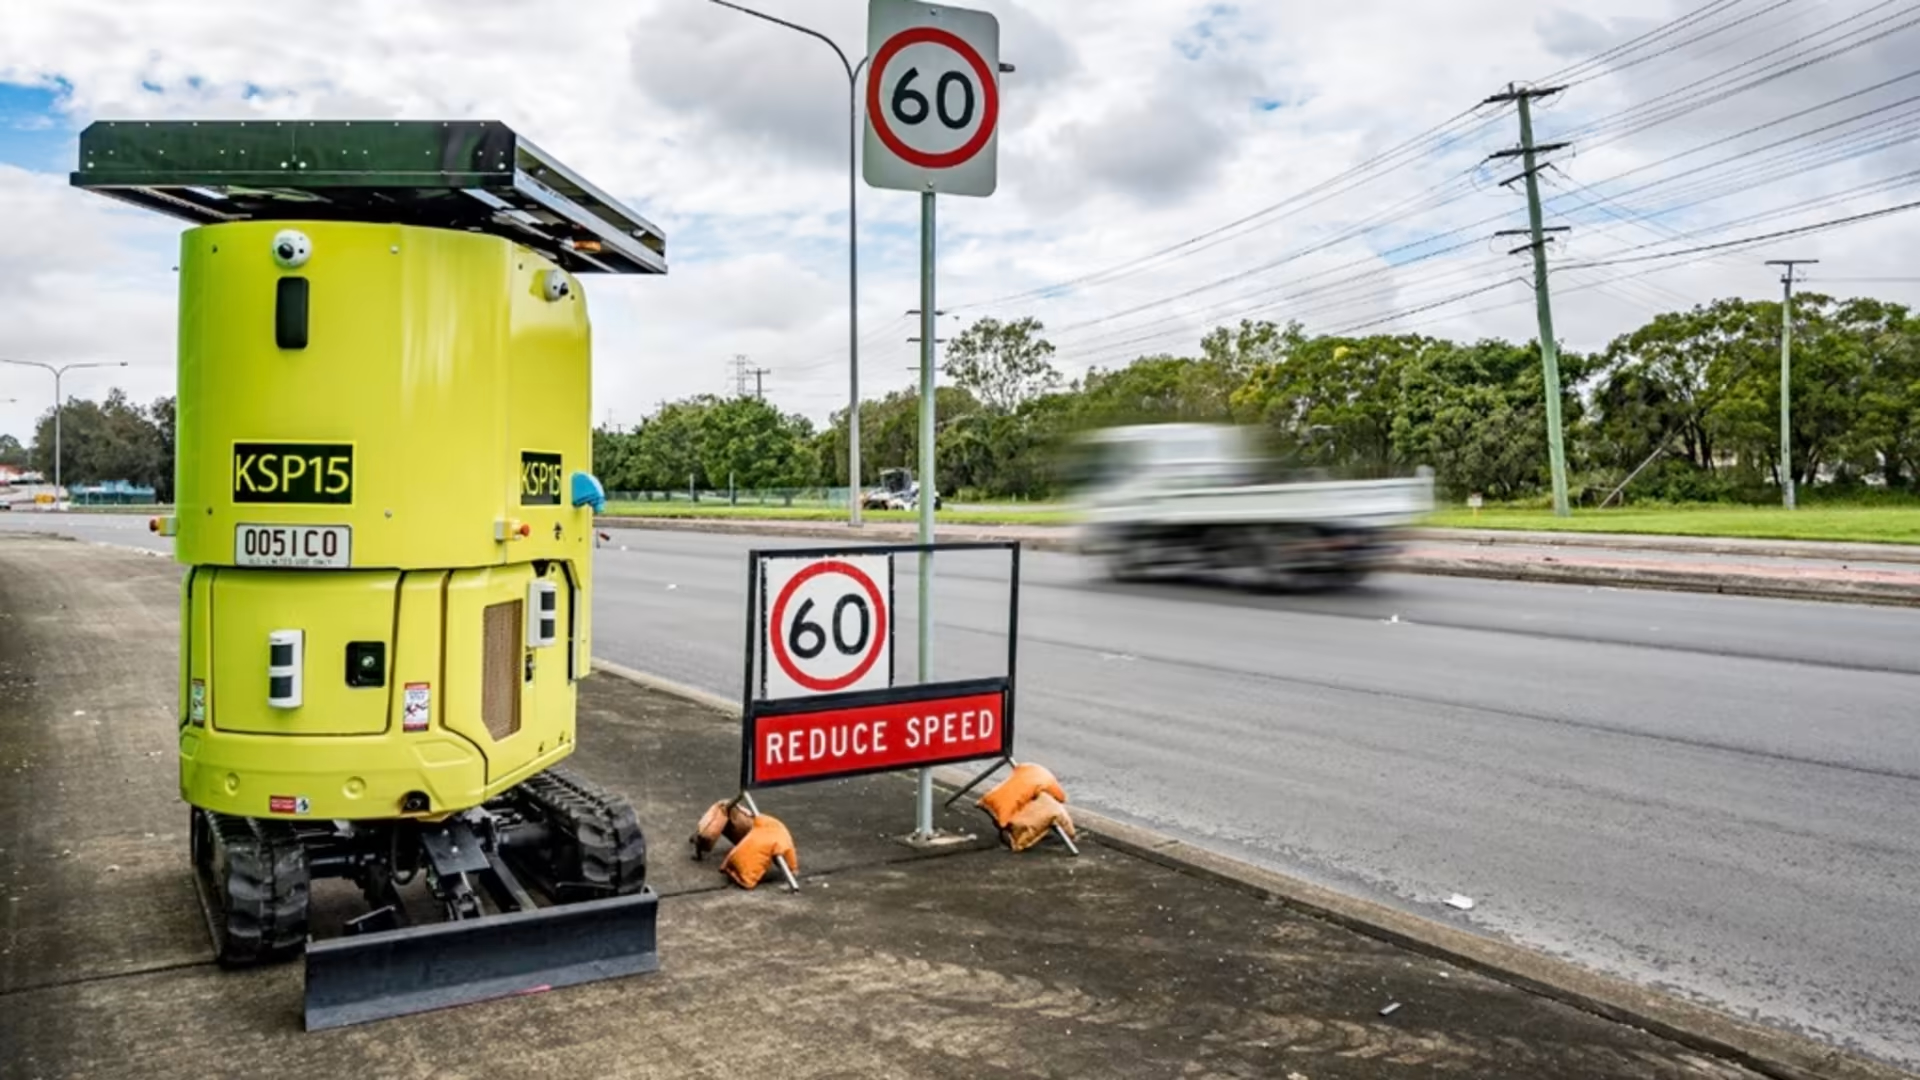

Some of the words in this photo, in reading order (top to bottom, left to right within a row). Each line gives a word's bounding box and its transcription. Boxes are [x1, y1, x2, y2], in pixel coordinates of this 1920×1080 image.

[891, 66, 975, 130] 60
[235, 453, 350, 494] KSP15
[520, 461, 561, 496] KSP15
[789, 593, 870, 659] 60
[766, 721, 888, 765] REDUCE
[905, 709, 994, 748] SPEED
